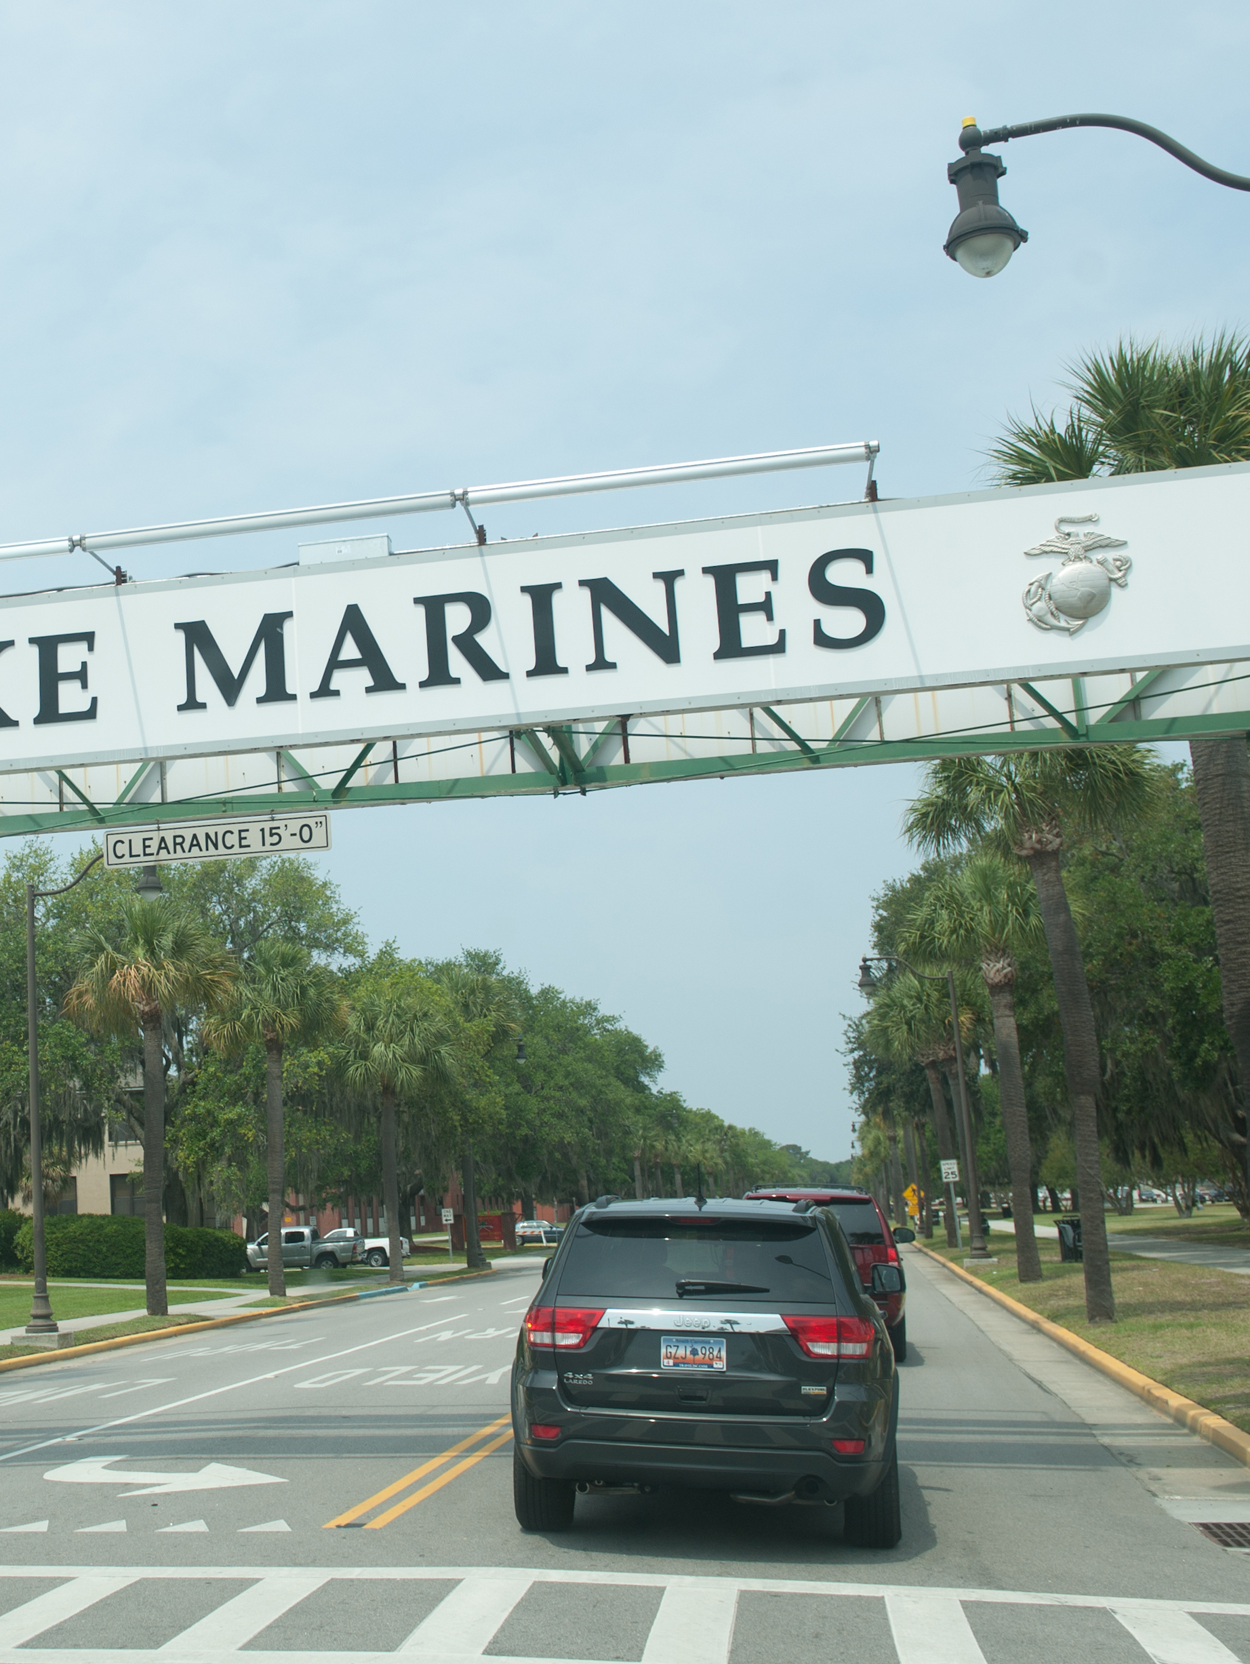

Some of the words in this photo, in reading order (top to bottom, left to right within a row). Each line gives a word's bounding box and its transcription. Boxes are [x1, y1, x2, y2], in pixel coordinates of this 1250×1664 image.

[173, 546, 887, 713] MARINES
[112, 828, 251, 860] CLEARANCE
[943, 1171, 958, 1180] 25
[673, 1315, 711, 1329] Jeep
[140, 1336, 327, 1362] THRU
[665, 1344, 688, 1360] GZJ
[700, 1345, 723, 1361] 984
[563, 1371, 594, 1379] 4x4
[563, 1378, 594, 1386] LAREDO
